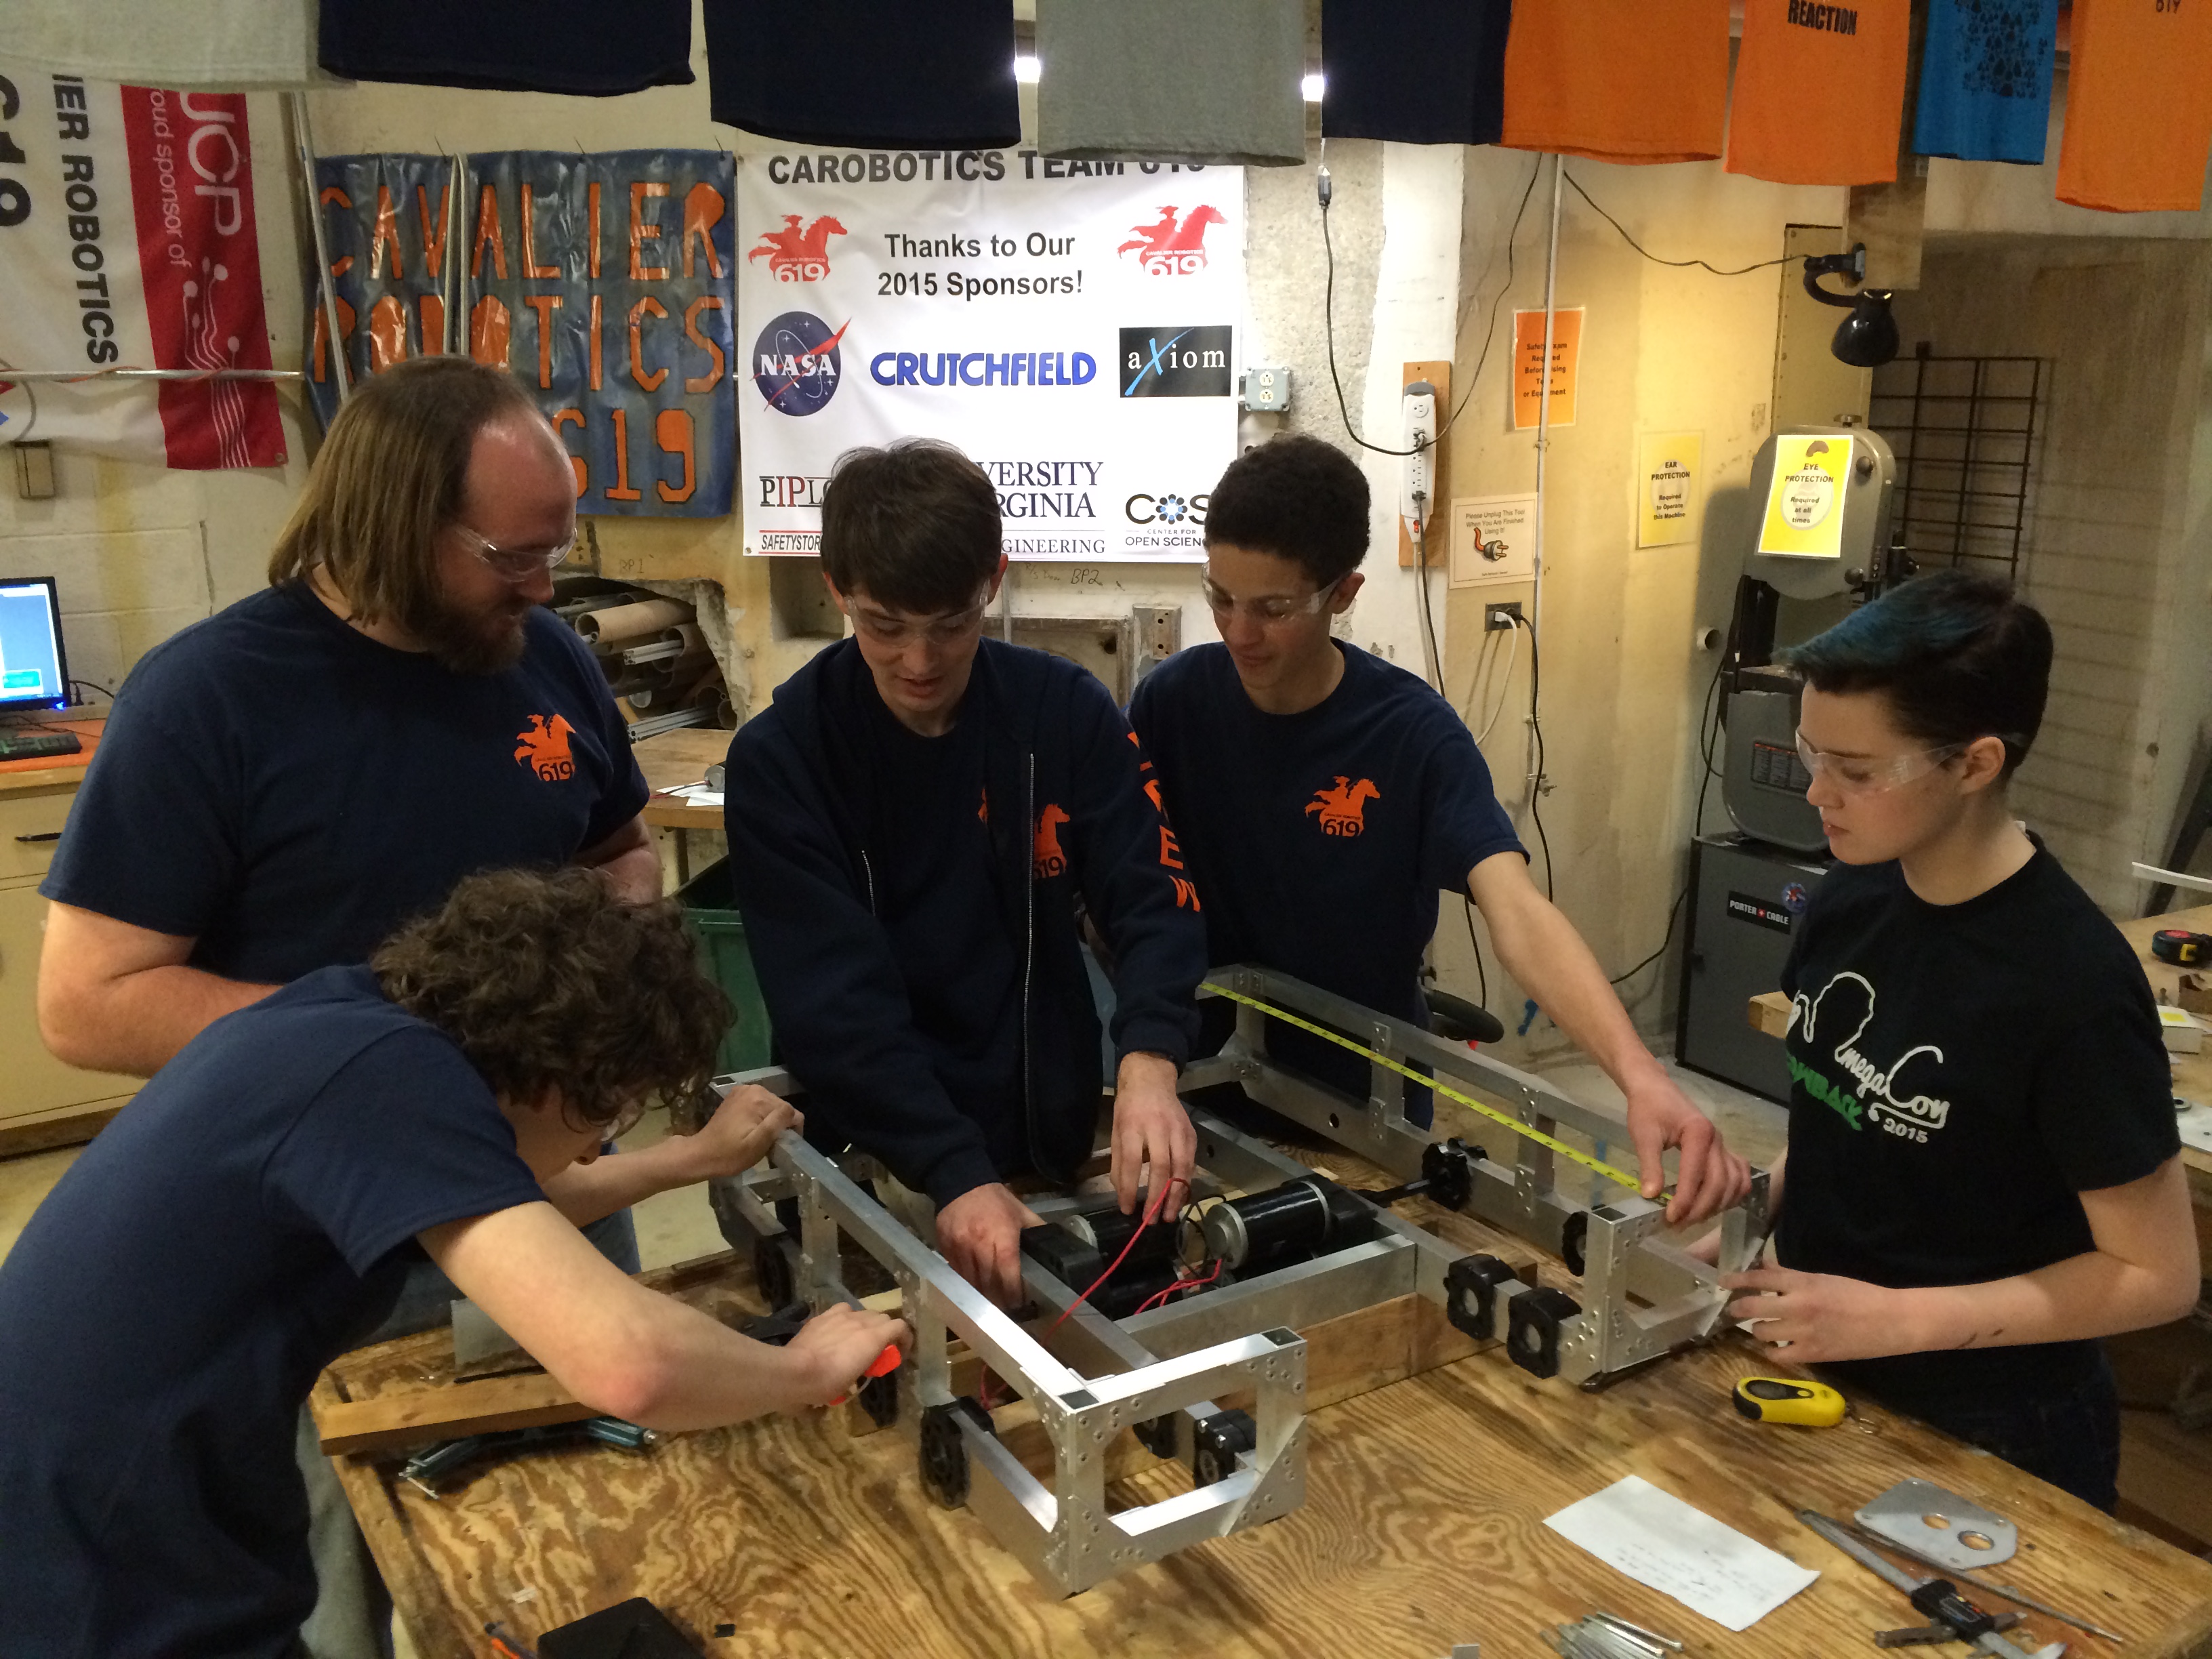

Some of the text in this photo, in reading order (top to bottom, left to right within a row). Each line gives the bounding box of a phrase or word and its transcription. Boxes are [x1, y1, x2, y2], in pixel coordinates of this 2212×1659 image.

[1787, 0, 1858, 35] REACTION
[150, 89, 192, 268] oud sponsor of
[768, 150, 1006, 184] CAROBOTICS
[884, 232, 1076, 258] Thanks to Our
[62, 155, 119, 364] ROBOTICS
[1145, 255, 1204, 276] 619
[775, 262, 825, 283] 619
[877, 270, 1082, 302] 2015 Sponsors!
[760, 354, 837, 377] NASA
[869, 351, 1097, 386] CRUTCHFIELD
[1651, 471, 1690, 480] PROTECTION
[1664, 461, 1677, 469] EAR
[1790, 495, 1820, 504] Required
[761, 534, 821, 552] SAFETYSTOR
[1125, 536, 1204, 547] OPEN SCIEN
[538, 760, 573, 782] 619
[1323, 818, 1360, 837] 619
[1729, 900, 1789, 926] PORTER CABLE
[1883, 1118, 1929, 1143] 2015
